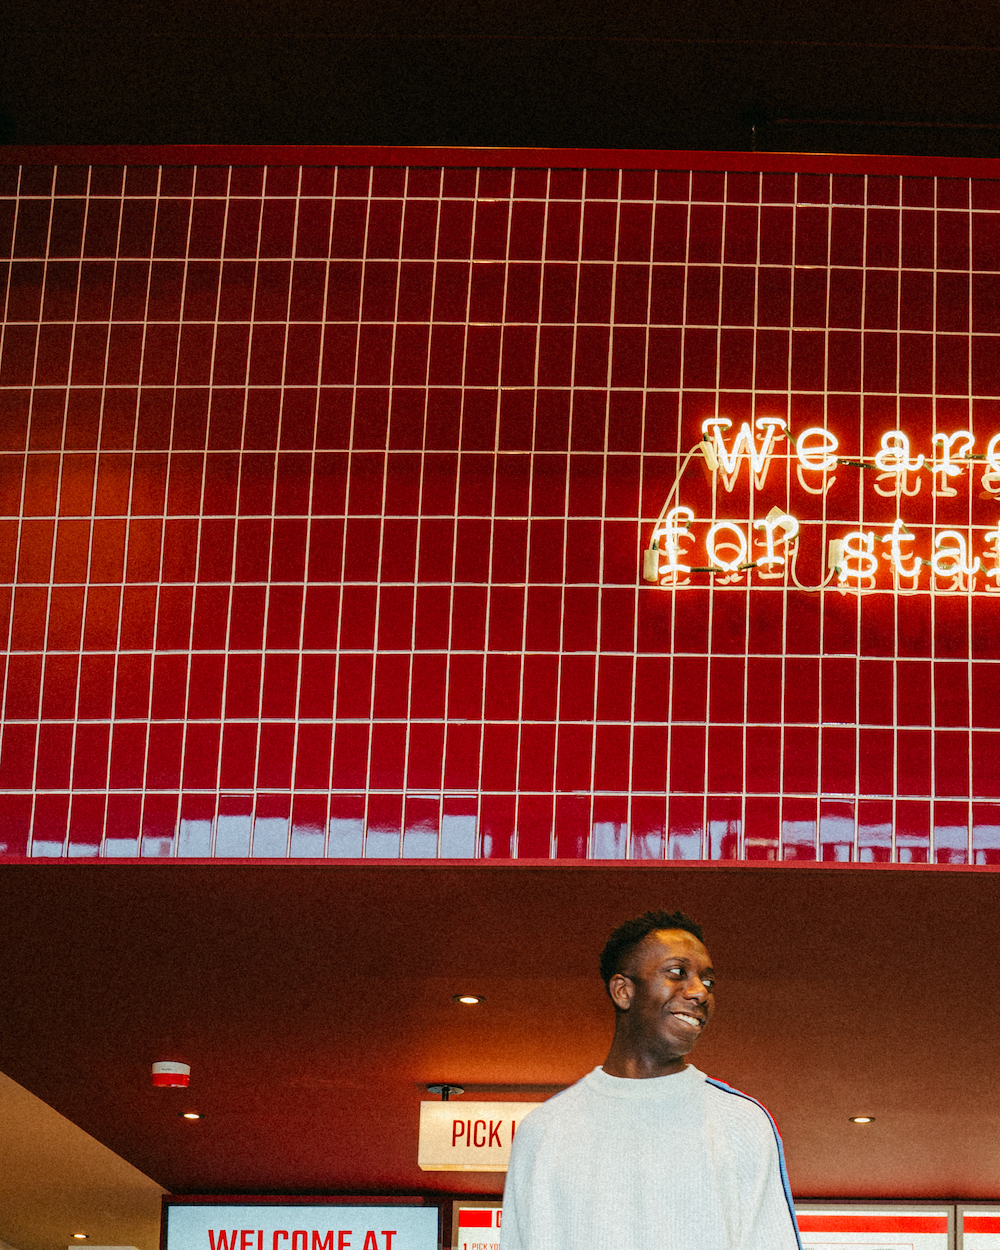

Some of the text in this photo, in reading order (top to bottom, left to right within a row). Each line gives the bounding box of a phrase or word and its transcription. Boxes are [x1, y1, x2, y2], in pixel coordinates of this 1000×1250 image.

[702, 417, 838, 475] We
[655, 506, 799, 575] for
[453, 1119, 502, 1148] PICK
[471, 1243, 489, 1250] PICK
